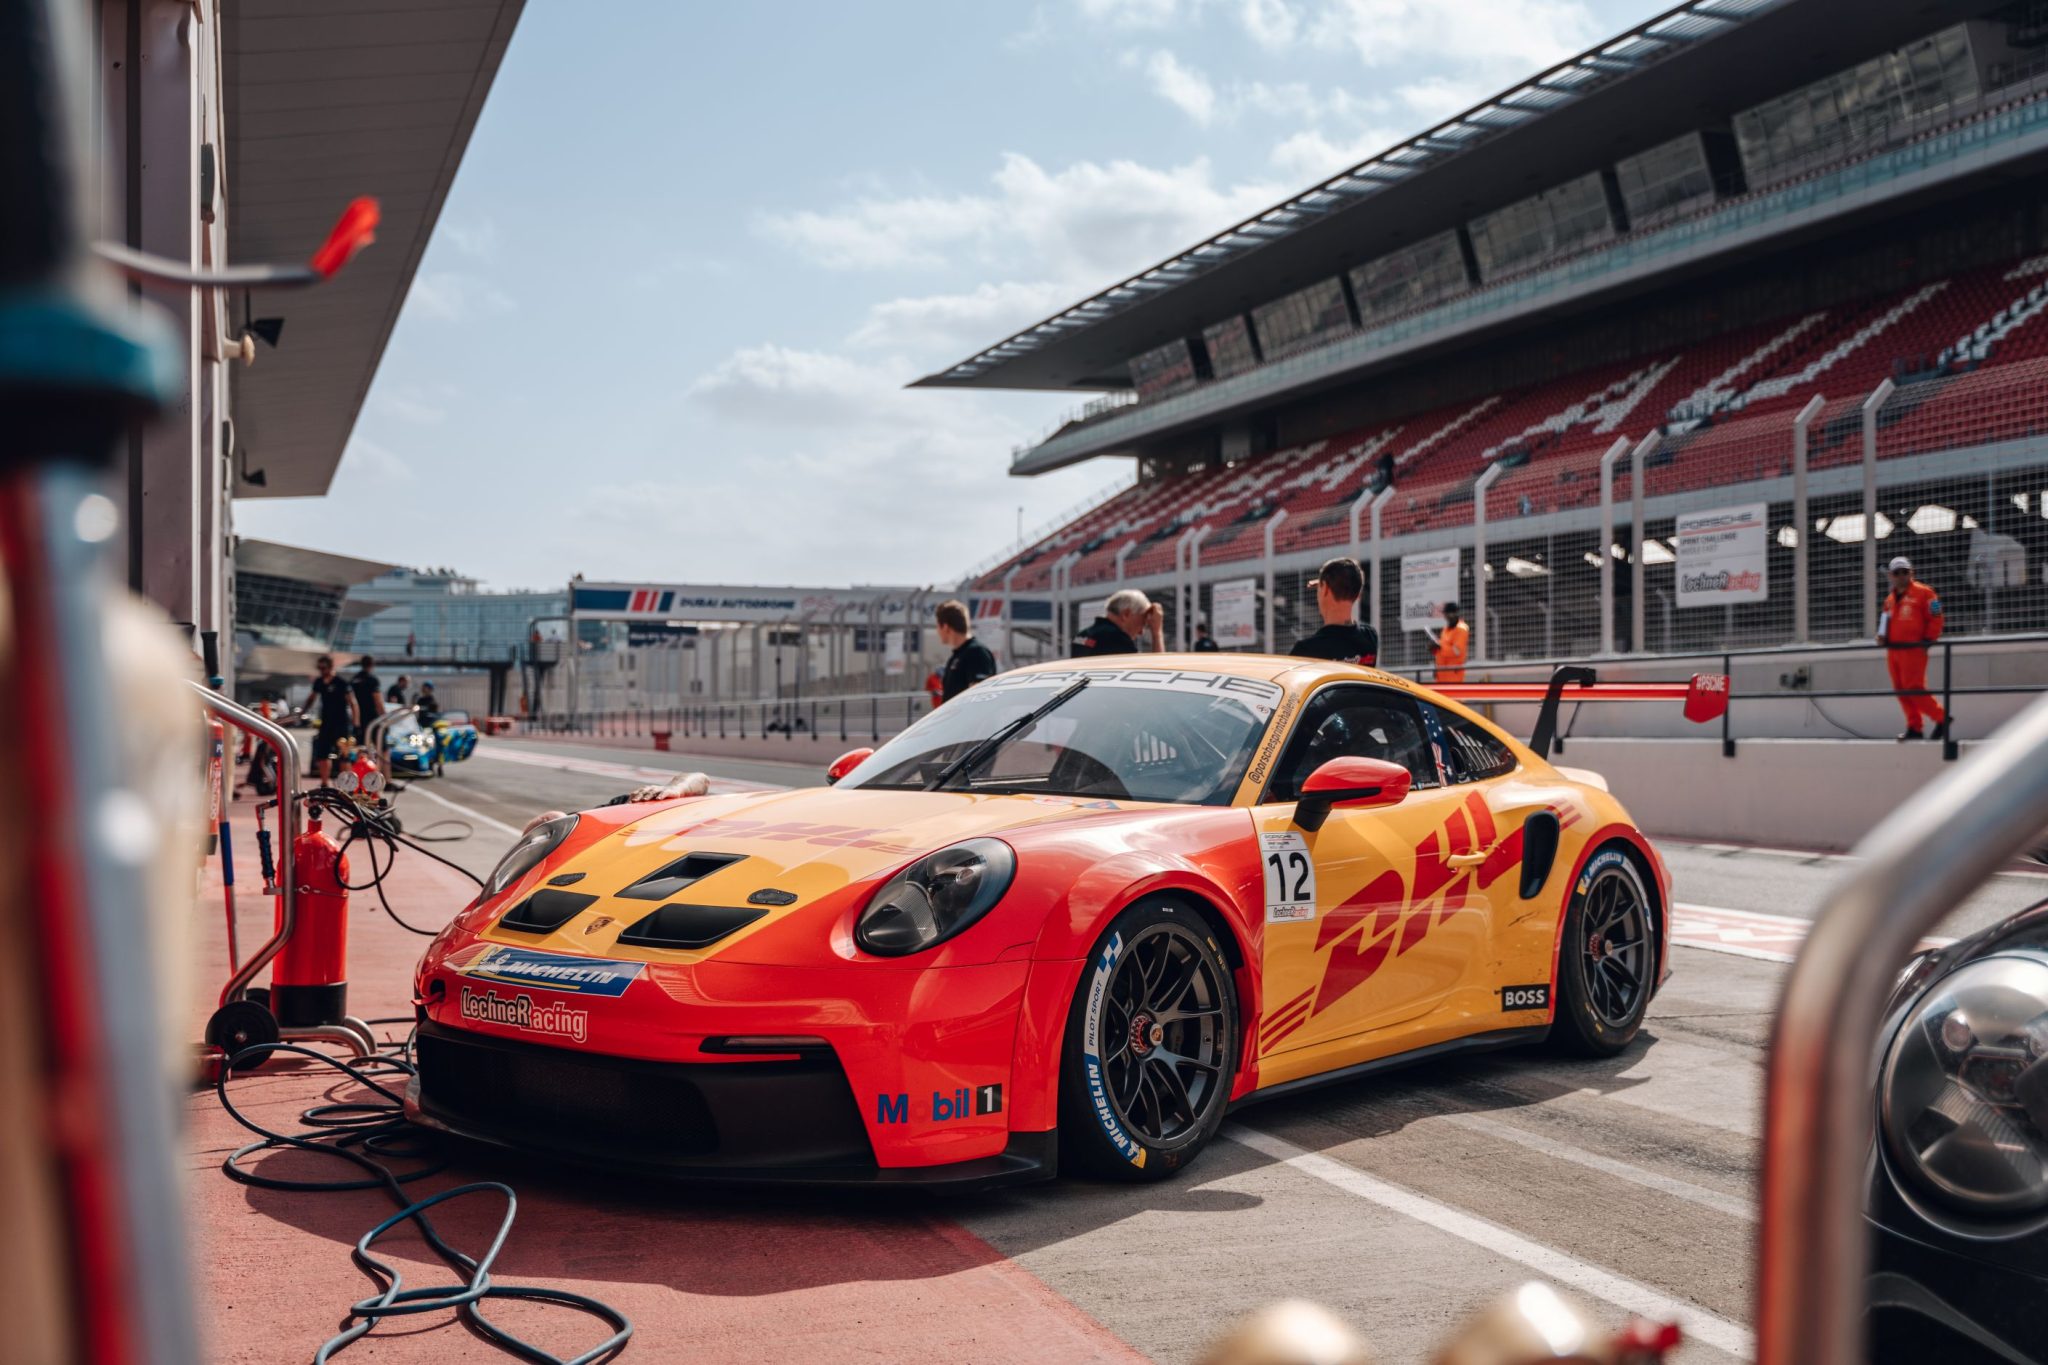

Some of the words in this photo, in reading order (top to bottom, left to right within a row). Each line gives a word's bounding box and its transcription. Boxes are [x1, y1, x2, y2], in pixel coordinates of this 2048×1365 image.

[679, 598, 718, 608] DUBAI
[720, 599, 796, 610] AUTODROME
[1696, 674, 1725, 692] #PSCME
[1268, 852, 1311, 902] 12
[1313, 789, 1524, 1018] DHL
[507, 960, 621, 985] MICHELIN
[1092, 981, 1104, 1013] SPORT
[1505, 989, 1545, 1007] BOSS
[461, 986, 589, 1044] LechneRacing
[1088, 1014, 1098, 1047] PILOT
[984, 1086, 993, 1112] 1
[1088, 1063, 1129, 1148] MICHELIN
